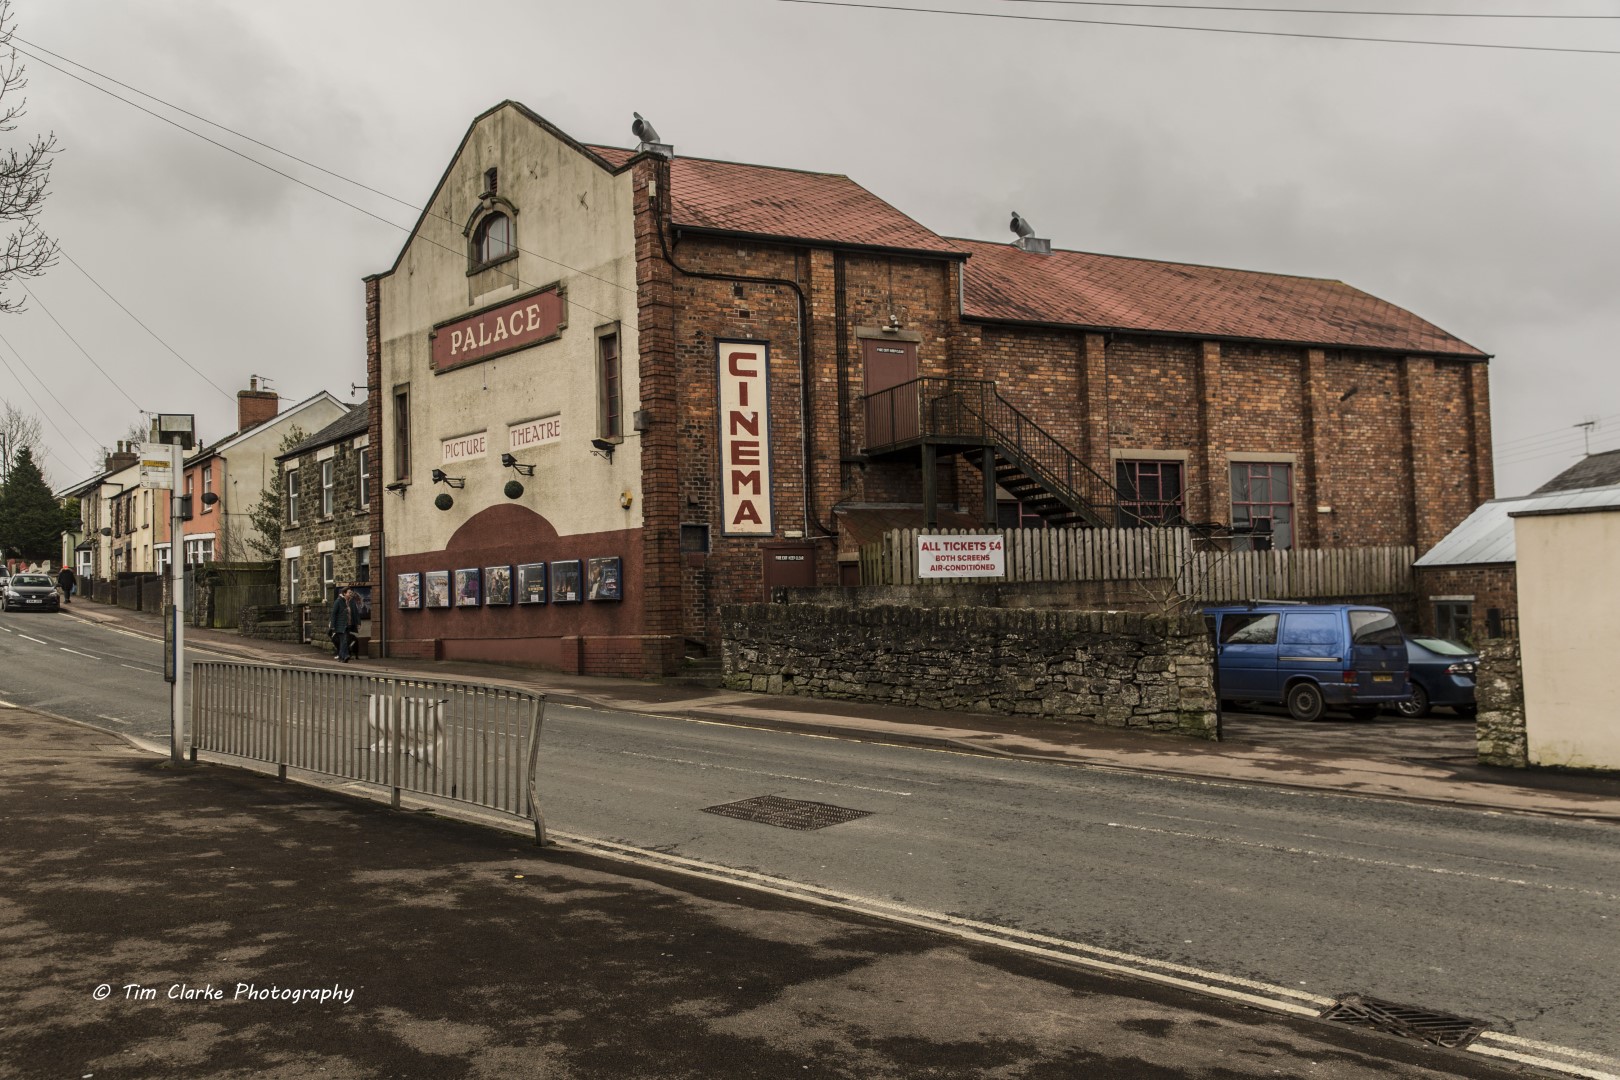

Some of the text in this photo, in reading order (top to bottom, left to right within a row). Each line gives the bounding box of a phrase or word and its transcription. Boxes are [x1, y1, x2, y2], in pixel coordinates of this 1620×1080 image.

[451, 304, 540, 355] PALACE
[445, 419, 561, 459] PICTURE THEATRE
[728, 352, 762, 524] CINEMA
[921, 541, 1001, 551] ALL TICKETS £4
